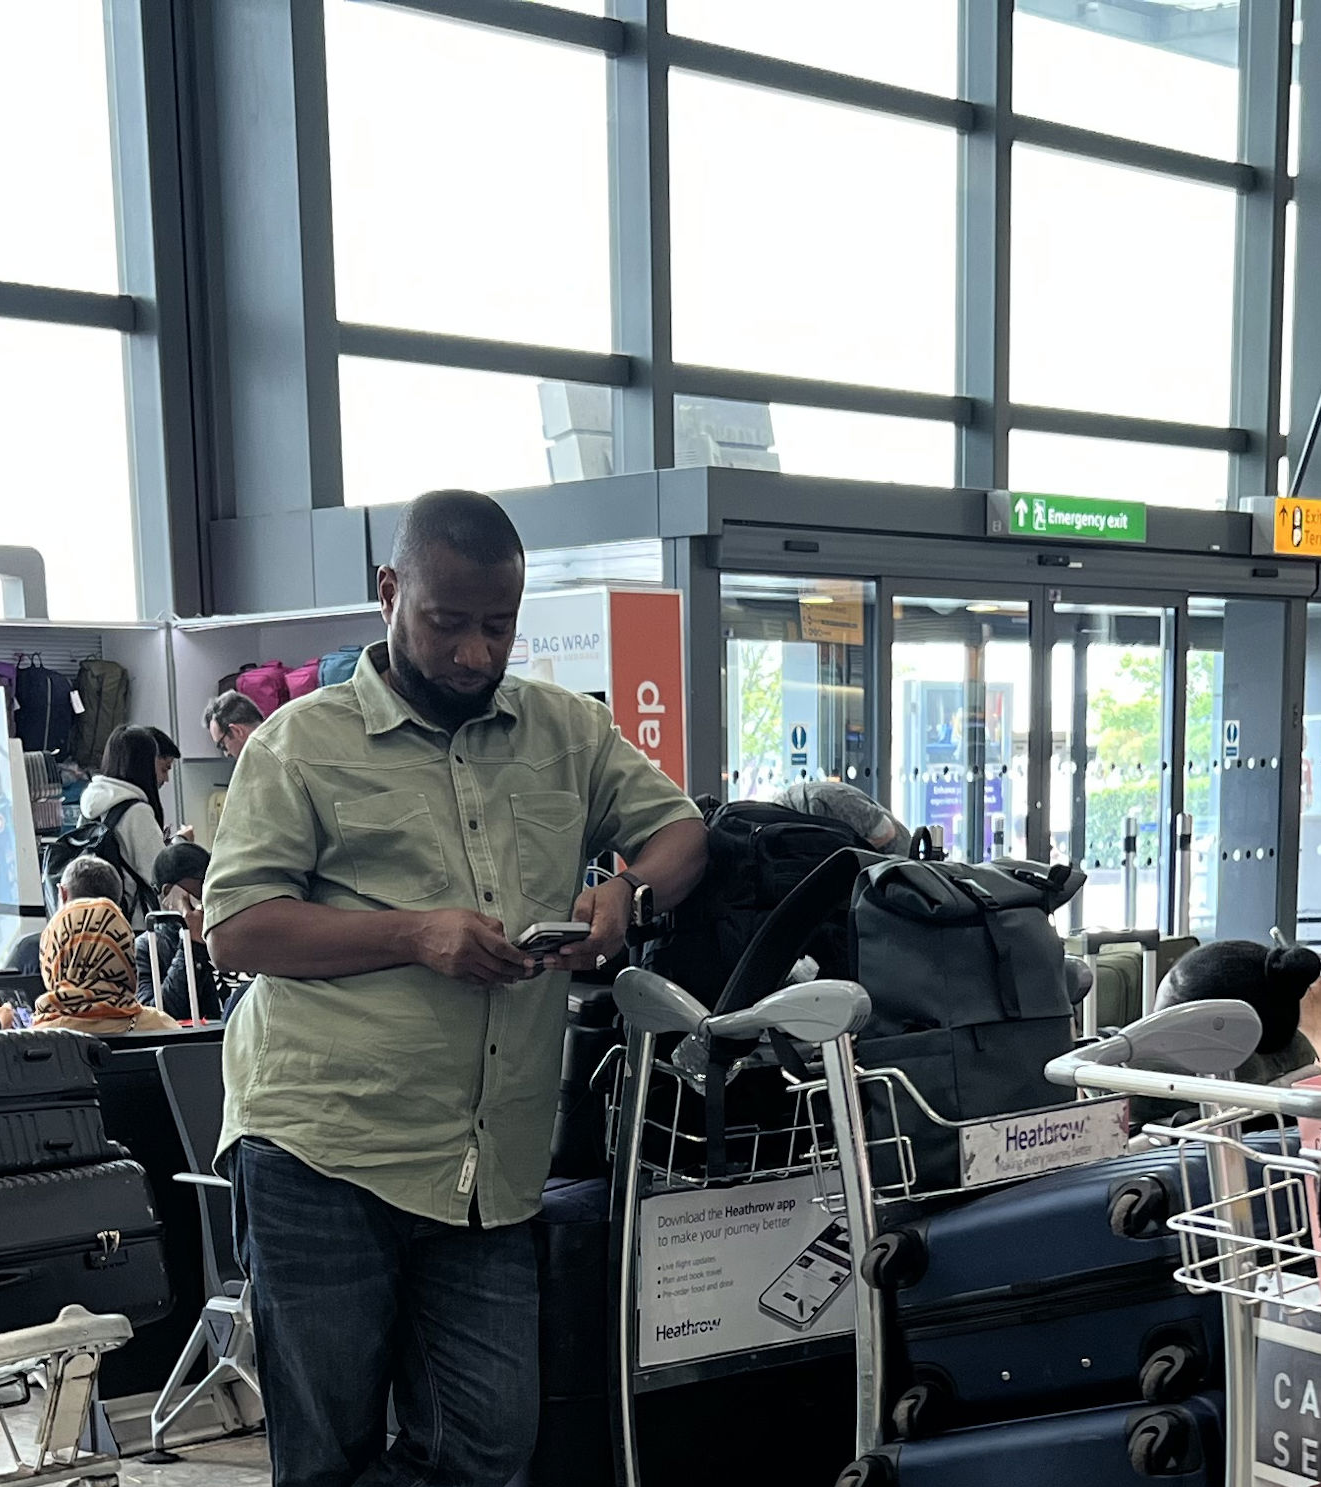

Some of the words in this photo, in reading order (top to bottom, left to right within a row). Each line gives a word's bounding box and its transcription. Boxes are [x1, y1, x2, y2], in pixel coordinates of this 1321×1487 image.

[1048, 508, 1106, 531] Emergency
[1107, 513, 1128, 529] exit
[533, 635, 559, 653] BAG
[562, 633, 600, 651] WRAP
[1006, 1118, 1085, 1152] Heathrow
[658, 1209, 705, 1228] Download
[708, 1208, 723, 1220] the
[725, 1201, 774, 1218] Heathrow
[777, 1199, 796, 1211] app
[658, 1236, 668, 1247] to
[671, 1232, 698, 1245] make
[700, 1228, 722, 1243] your
[724, 1223, 760, 1240] journey
[763, 1217, 792, 1231] better
[656, 1318, 721, 1342] Heathrow
